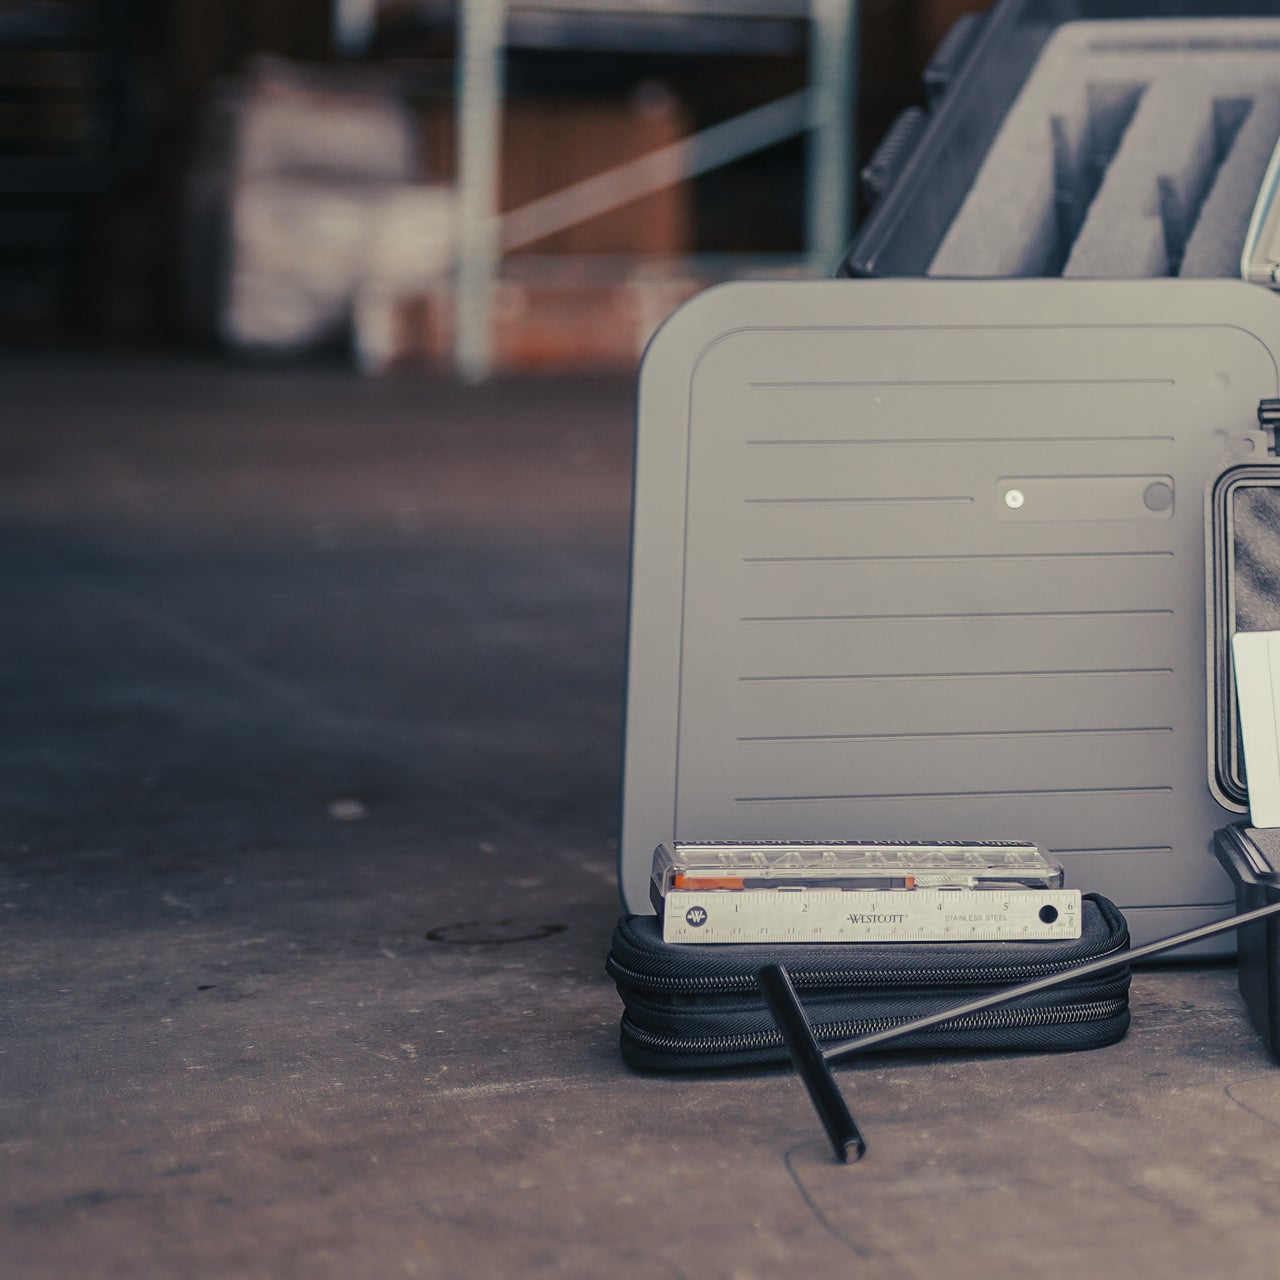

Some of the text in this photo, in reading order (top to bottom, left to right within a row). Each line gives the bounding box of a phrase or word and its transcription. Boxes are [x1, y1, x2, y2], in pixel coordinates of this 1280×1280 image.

[735, 902, 1074, 913] 1 2 3 4 5 6
[944, 914, 1008, 922] STAINLESS STEEL
